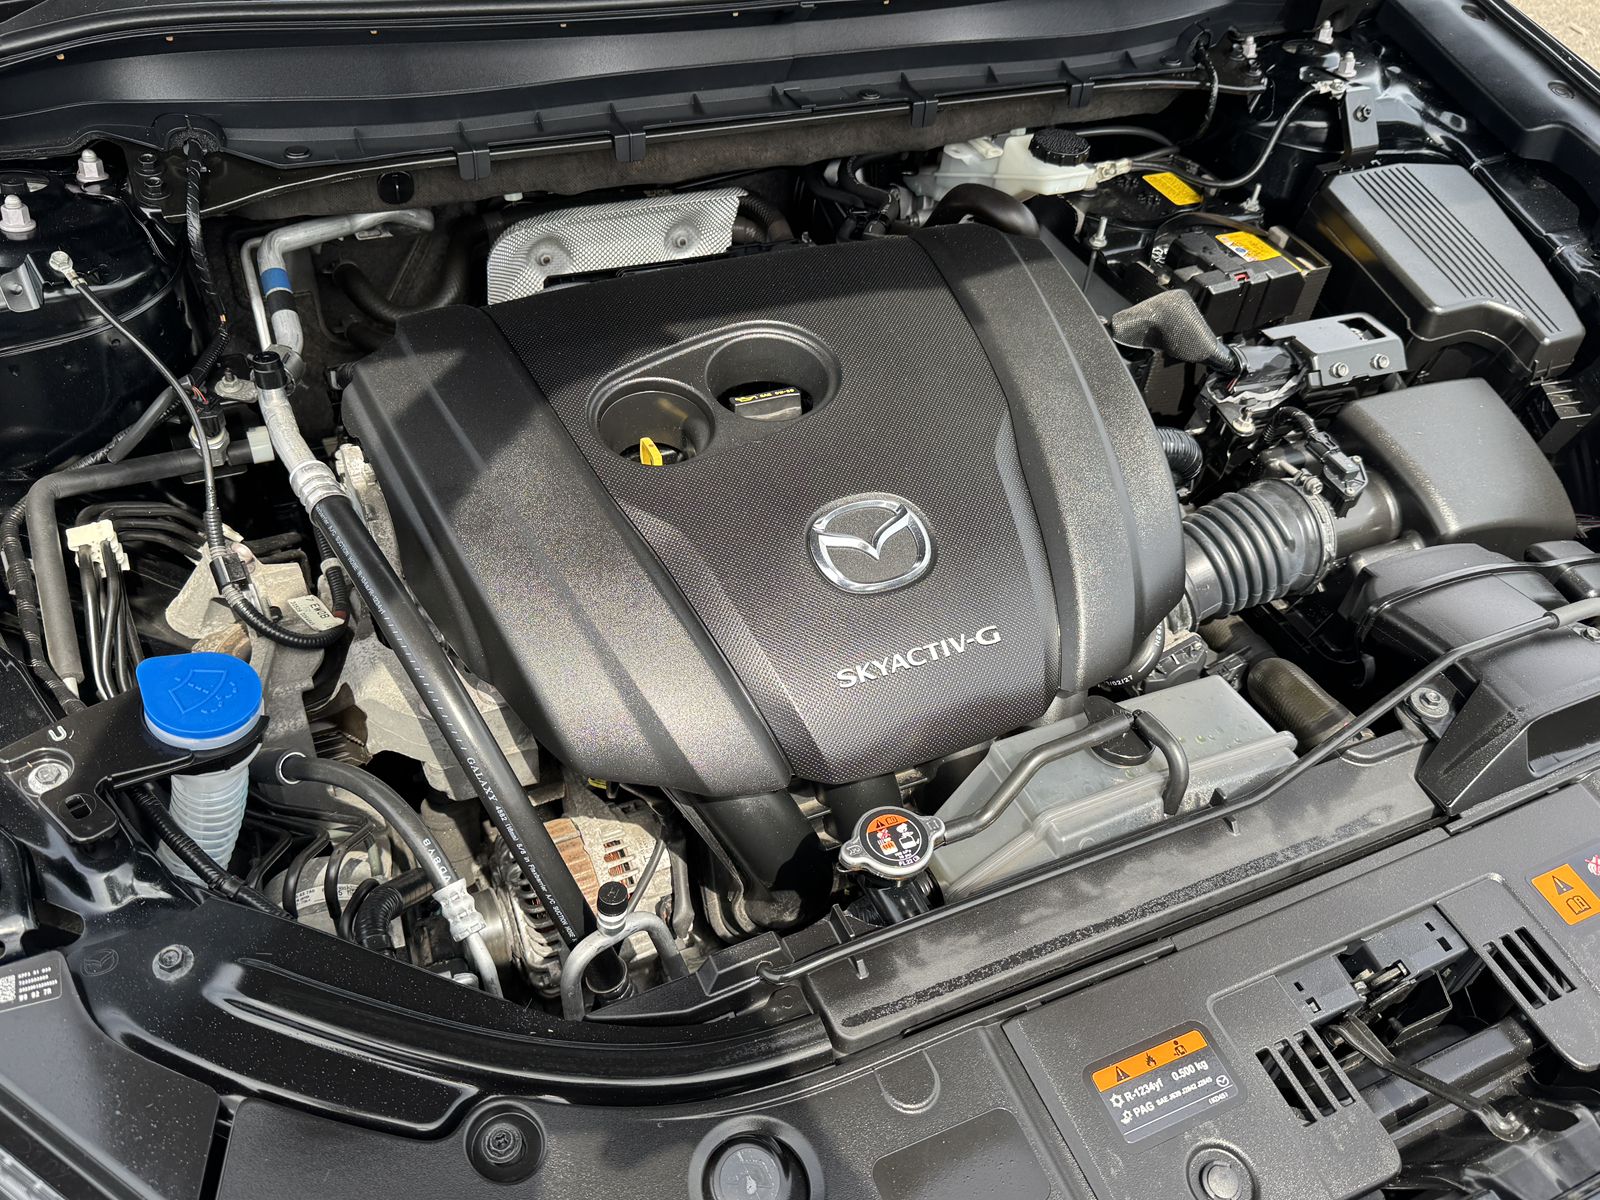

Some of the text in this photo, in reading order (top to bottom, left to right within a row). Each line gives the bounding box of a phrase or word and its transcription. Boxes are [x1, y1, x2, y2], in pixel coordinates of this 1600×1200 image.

[836, 625, 1001, 688] SKYACTIV-G
[466, 757, 498, 803] GALAXY
[1124, 1060, 1209, 1102] R-1234yf 0.500 kg
[1132, 1101, 1155, 1117] PAG
